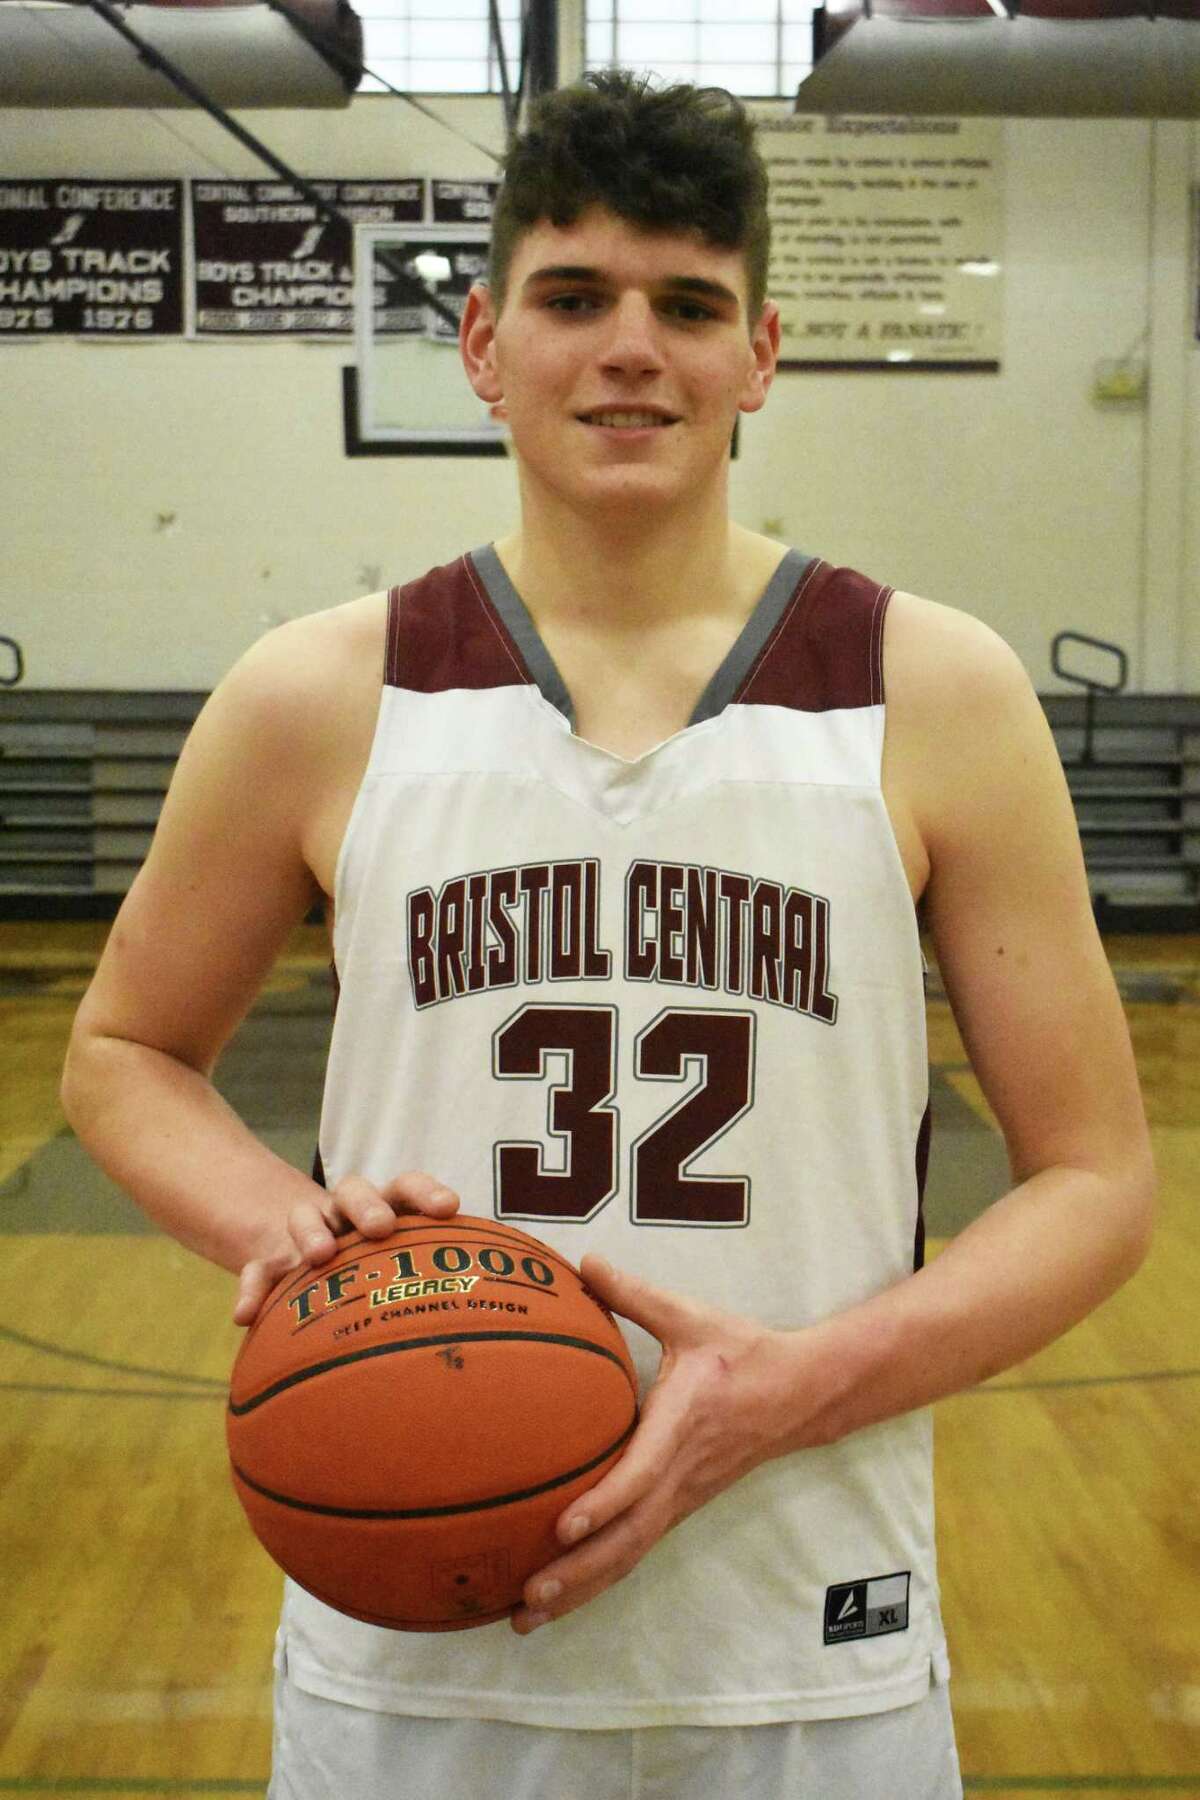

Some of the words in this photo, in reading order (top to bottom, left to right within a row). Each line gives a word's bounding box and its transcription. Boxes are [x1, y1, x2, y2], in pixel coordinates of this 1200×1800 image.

[56, 185, 175, 210] CONFERENCE
[223, 205, 317, 222] SOUTHERN
[60, 249, 171, 273] TRACK
[198, 261, 255, 282] BOYS
[259, 261, 333, 281] TRACK
[232, 283, 387, 307] CHAMPIOS
[82, 307, 153, 329] 1976
[406, 857, 613, 1012] BRISTOL
[624, 858, 839, 1026] CENTRAL
[491, 1001, 757, 1228] 32
[287, 1246, 555, 1325] TF-1000
[370, 1275, 480, 1309] LEGACY
[381, 1301, 460, 1321] CHANNEL
[467, 1299, 528, 1315] DESIGN
[878, 1608, 898, 1627] XL
